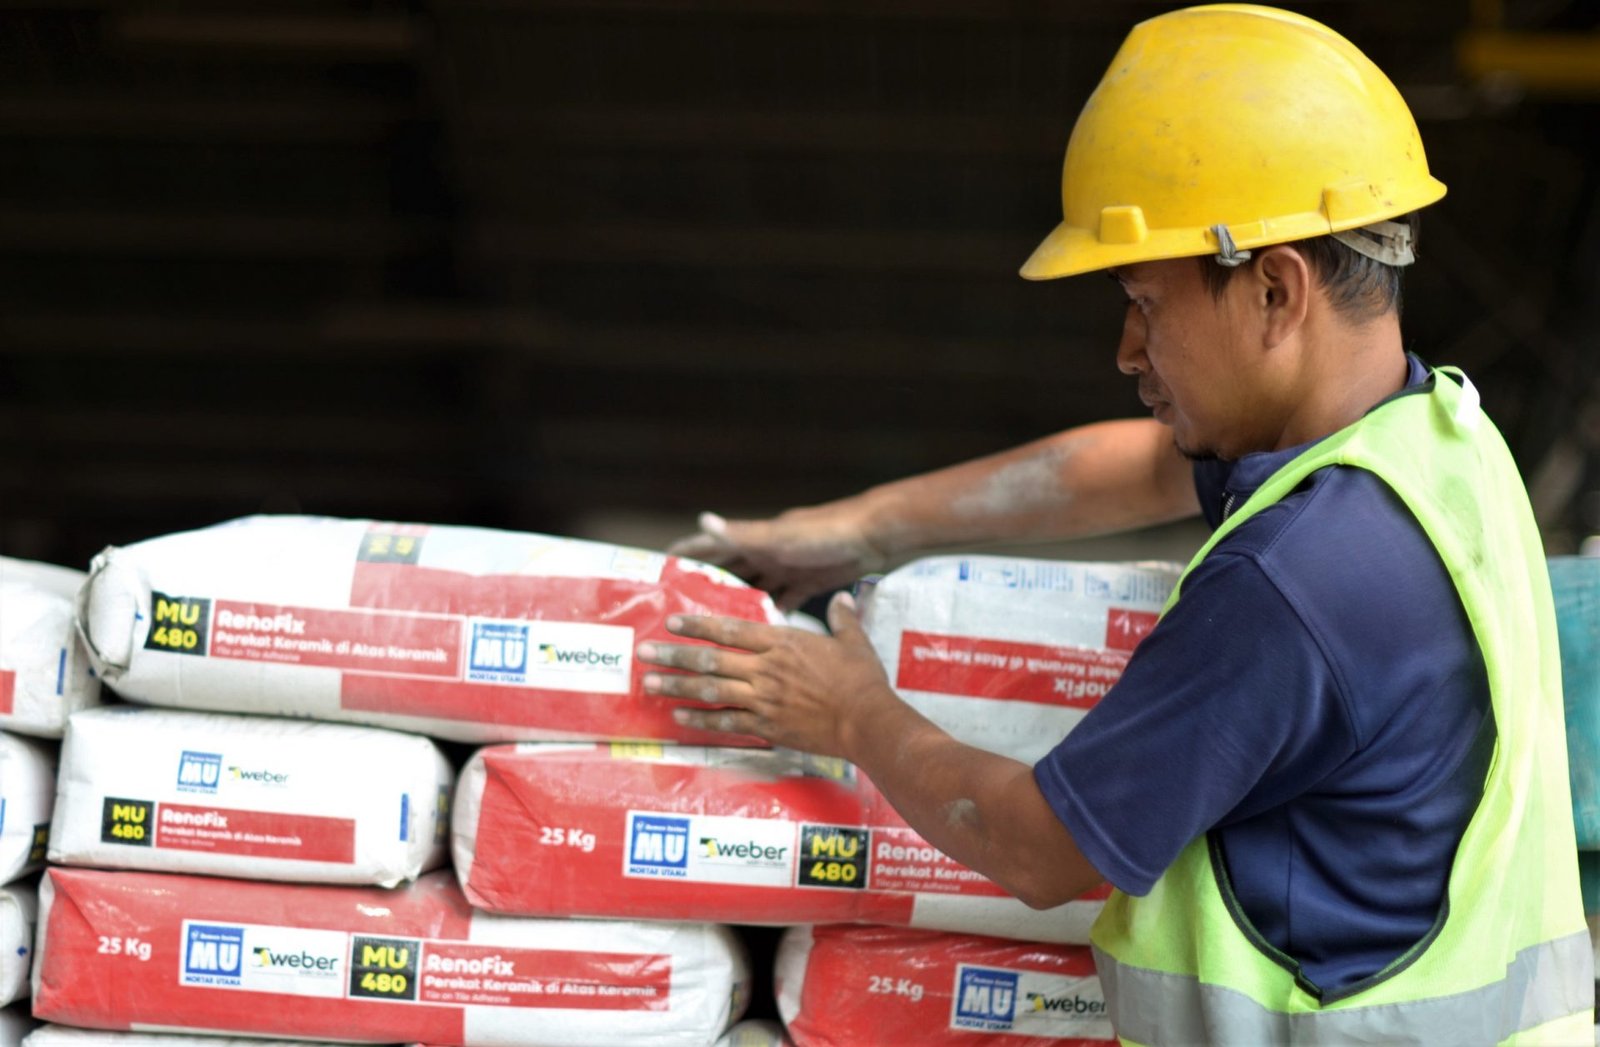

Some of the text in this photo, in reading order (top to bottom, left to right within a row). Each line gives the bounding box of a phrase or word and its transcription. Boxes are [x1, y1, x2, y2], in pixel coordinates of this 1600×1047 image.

[156, 599, 199, 625] MU
[217, 609, 306, 635] RenoFix
[153, 626, 197, 649] 480
[215, 630, 448, 663] Perekat Keramik di Atas Keramik
[474, 639, 524, 668] MU
[555, 645, 623, 666] weber
[1009, 656, 1025, 672] di
[1054, 678, 1113, 700] noFix
[180, 761, 219, 785] MU
[241, 769, 289, 783] weber
[112, 804, 145, 823] MU
[162, 808, 228, 828] RenoFix
[111, 824, 144, 840] 480
[540, 827, 596, 852] 25 Kg
[634, 832, 686, 863] MU
[717, 840, 787, 860] weber
[811, 835, 858, 858] MU
[877, 842, 956, 864] RenoF
[810, 861, 857, 882] 480
[876, 863, 991, 882] Perekat Keram
[98, 936, 152, 961] 25 Kg
[189, 942, 240, 971] MU
[362, 945, 408, 968] MU
[269, 950, 338, 970] weber
[427, 953, 514, 976] RenoFix
[361, 973, 406, 993] 480
[424, 975, 657, 997] Perekat Keramik di Atas Keramik
[868, 975, 924, 1001] 25 Kg
[961, 985, 1013, 1016] MU
[1043, 994, 1106, 1014] weber
